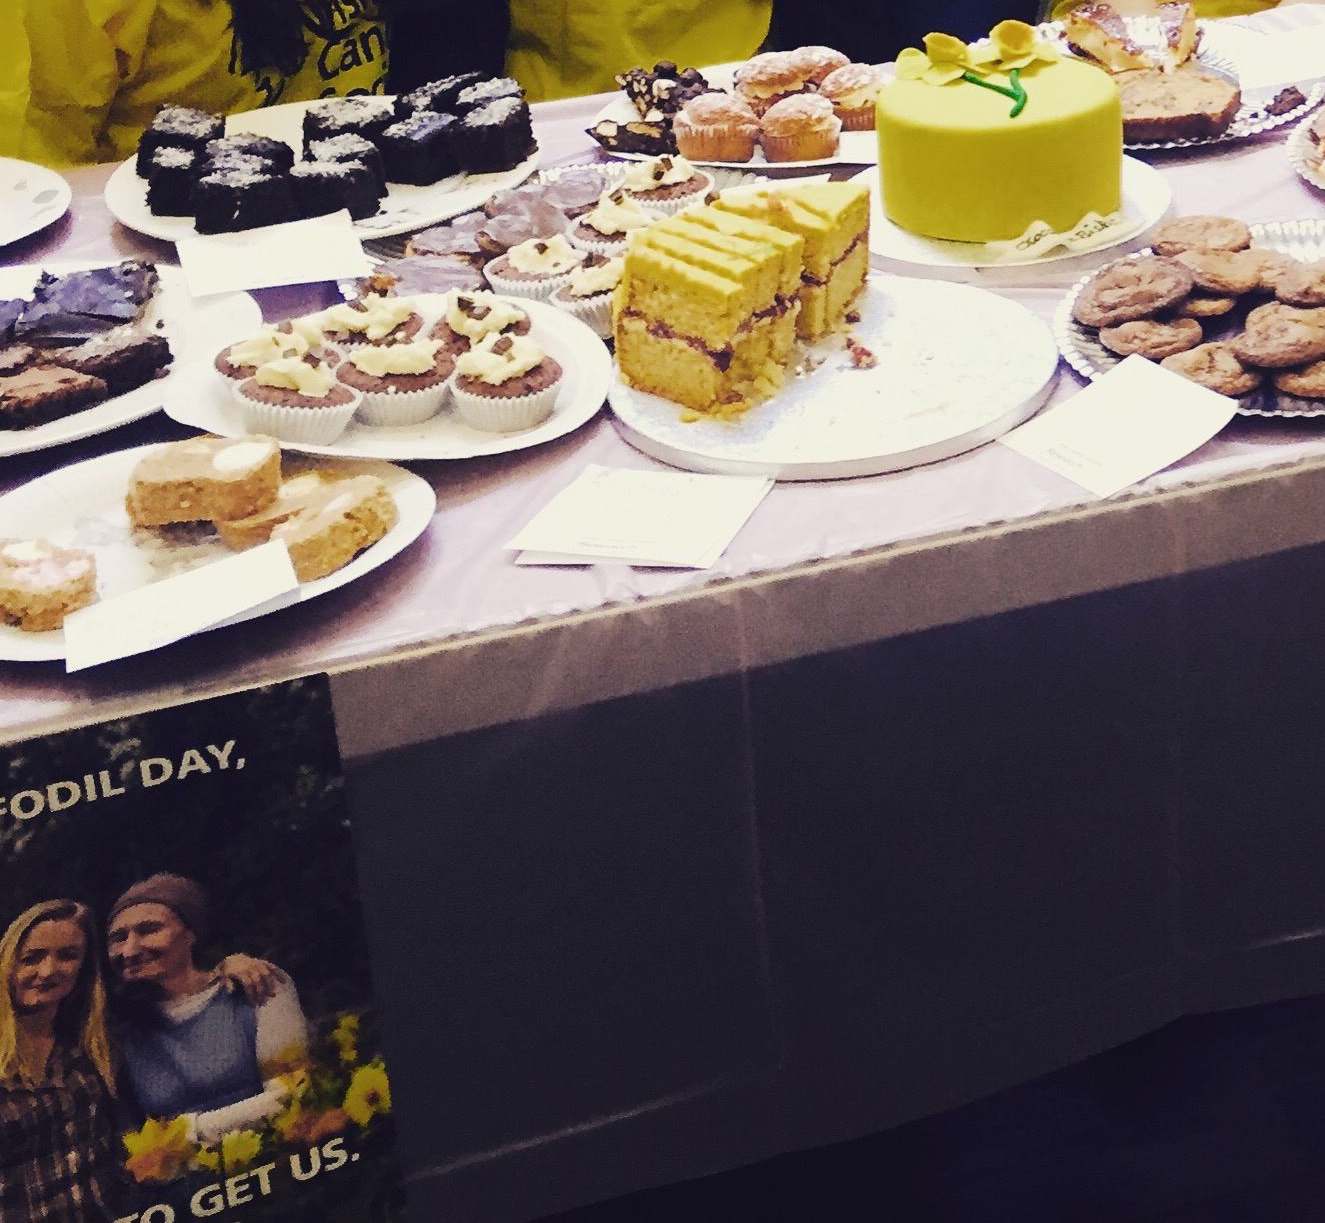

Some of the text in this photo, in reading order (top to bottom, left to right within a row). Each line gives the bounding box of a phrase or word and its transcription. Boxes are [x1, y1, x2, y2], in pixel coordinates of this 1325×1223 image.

[139, 739, 246, 788] DAY,
[189, 1162, 276, 1218] GET
[289, 1136, 360, 1182] US.
